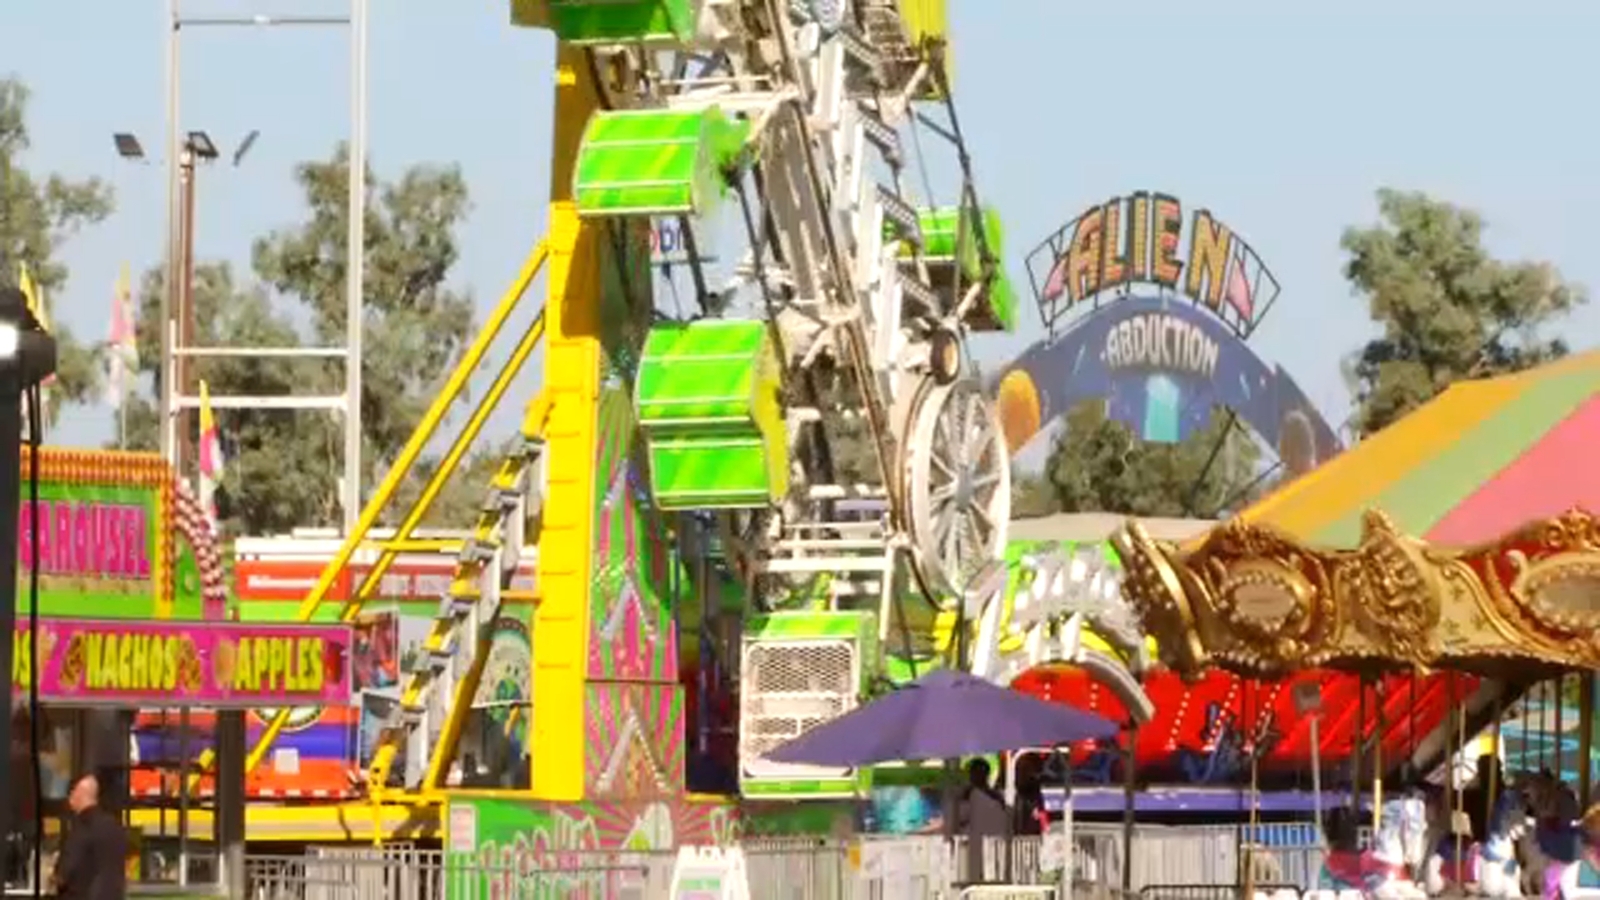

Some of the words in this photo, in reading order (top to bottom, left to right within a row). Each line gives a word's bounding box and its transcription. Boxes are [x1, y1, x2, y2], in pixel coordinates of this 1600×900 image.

[1064, 190, 1232, 312] ALIEN
[1106, 313, 1220, 378] ABDUCTION
[85, 632, 179, 690] NACHOS
[234, 636, 323, 690] APPLES
